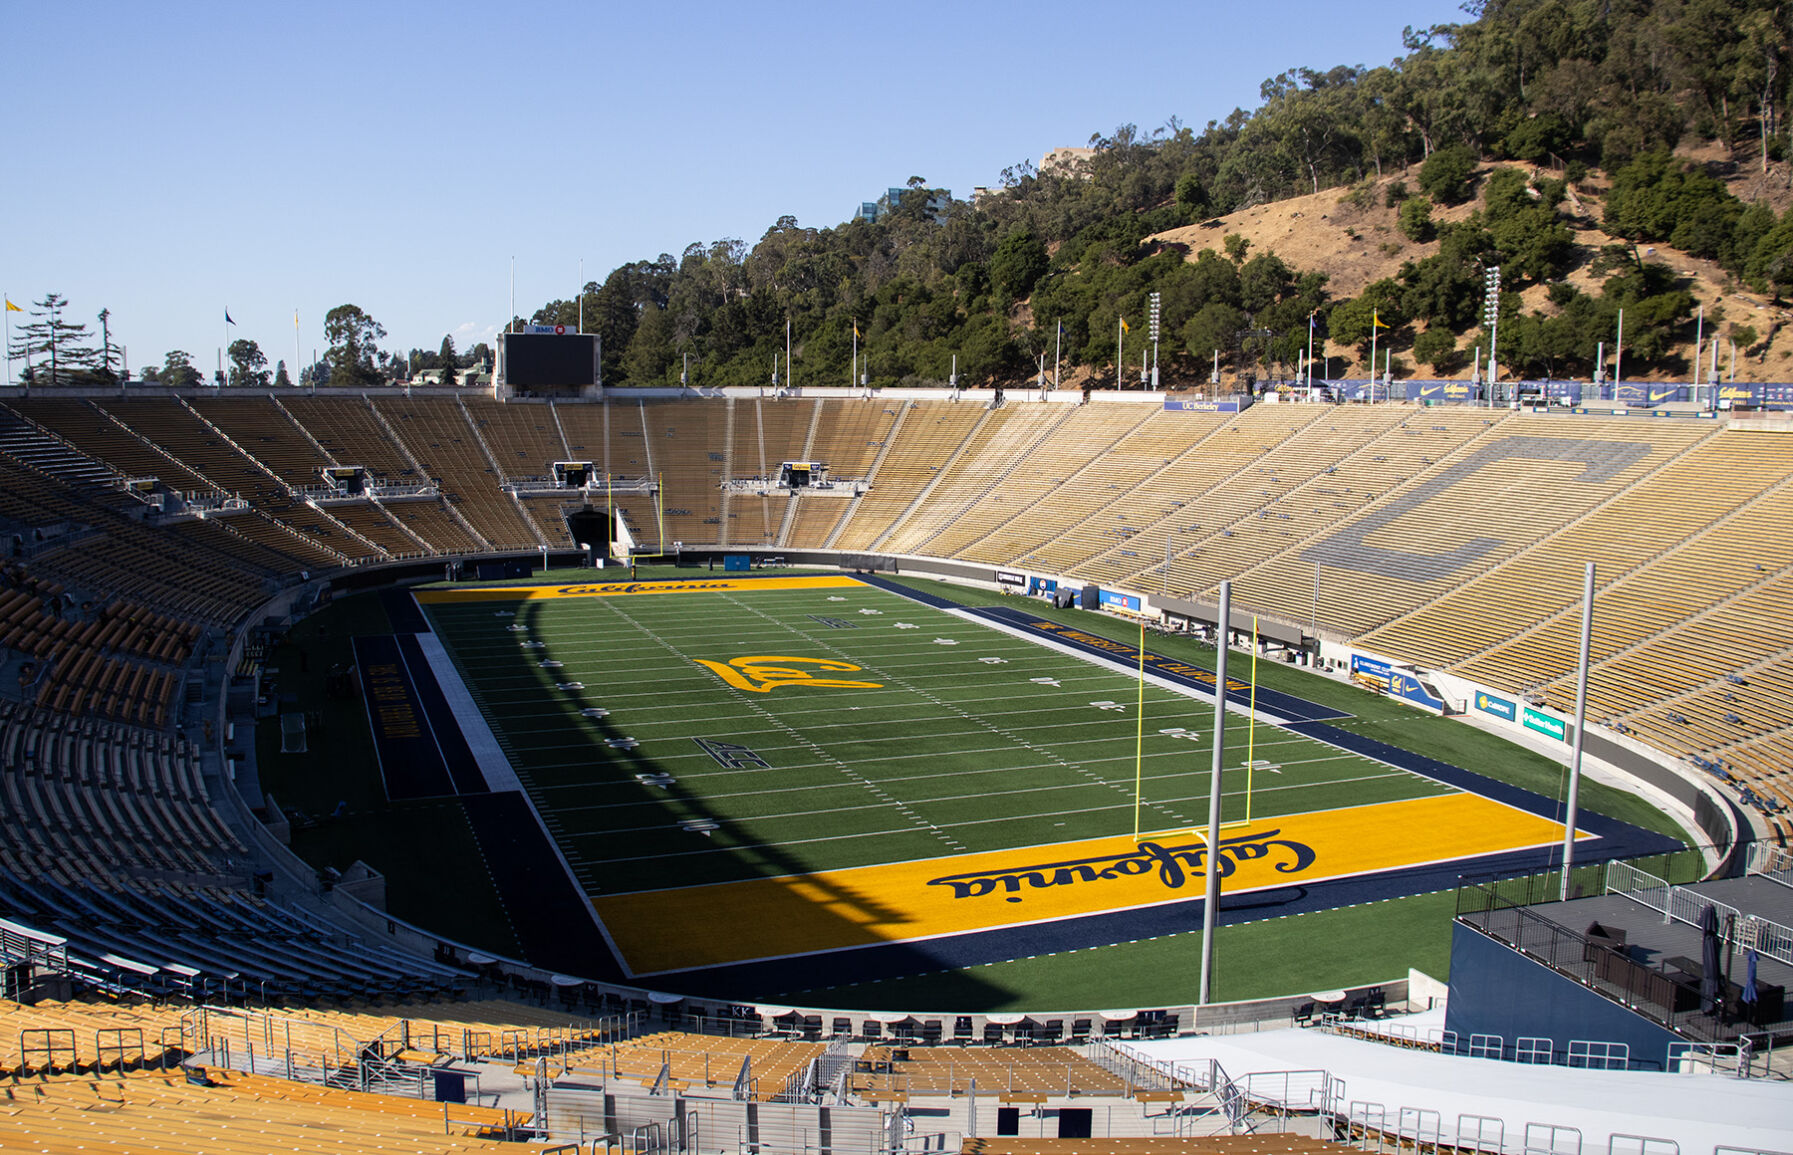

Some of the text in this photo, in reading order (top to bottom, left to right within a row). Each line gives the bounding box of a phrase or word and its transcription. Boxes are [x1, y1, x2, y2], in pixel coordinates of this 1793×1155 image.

[1182, 402, 1219, 411] UC Berkeley
[557, 582, 738, 596] California
[692, 655, 885, 693] Cal
[690, 736, 773, 769] ACC
[926, 828, 1317, 903] California
